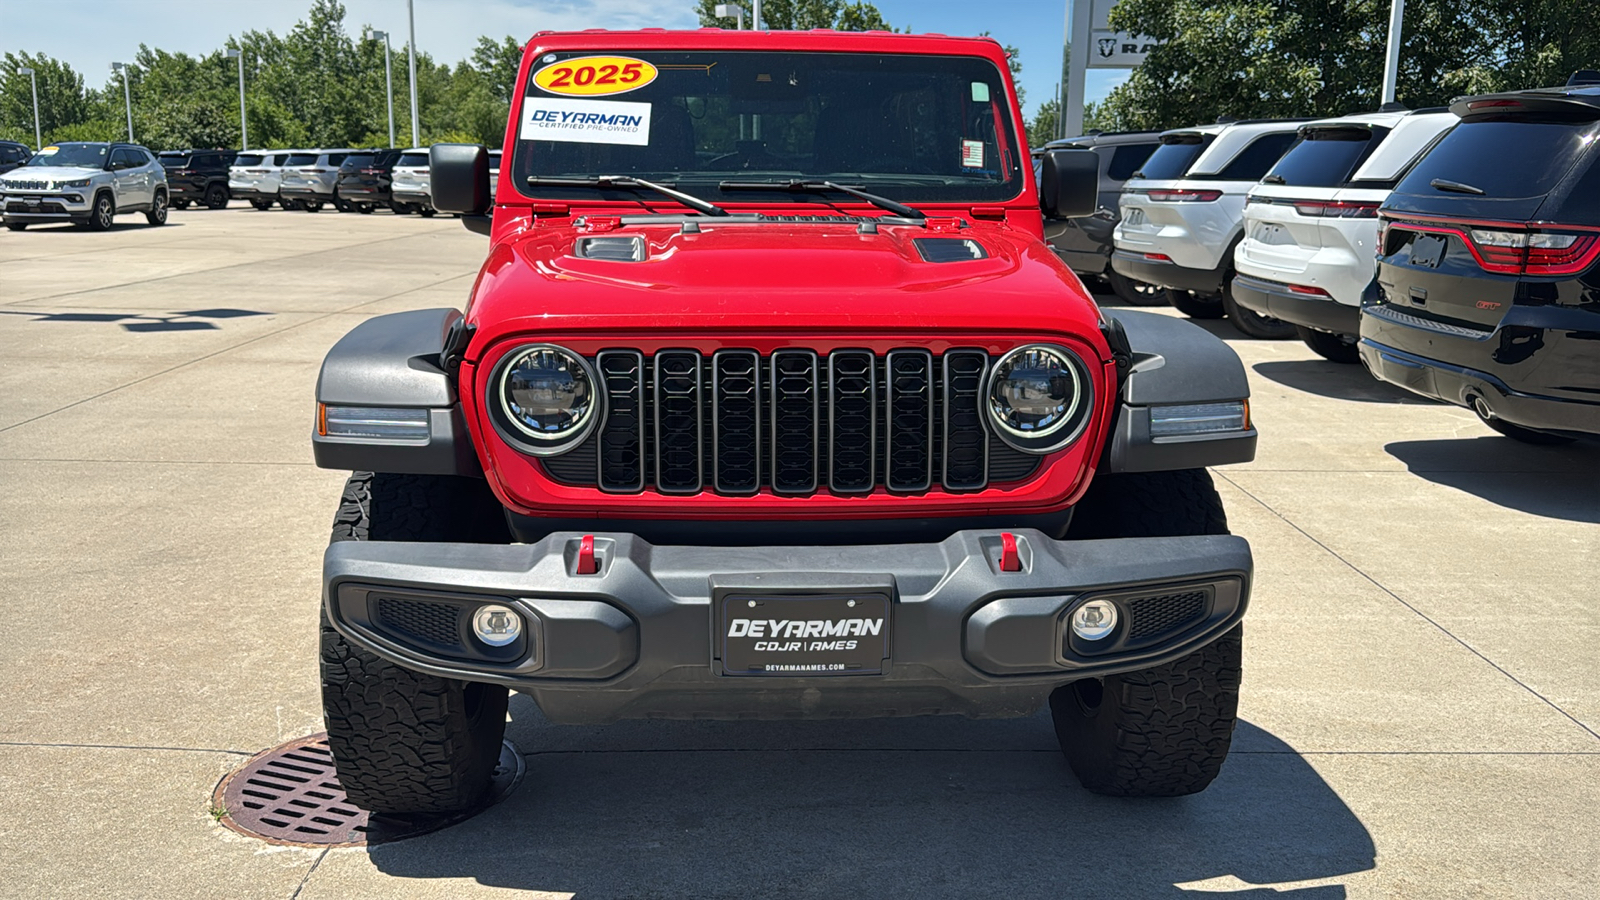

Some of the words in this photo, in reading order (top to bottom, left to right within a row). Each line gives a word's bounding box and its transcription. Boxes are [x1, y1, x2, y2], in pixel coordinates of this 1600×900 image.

[548, 63, 642, 88] 2025
[531, 109, 643, 126] DEYARMAN
[538, 121, 585, 129] CERTIFIED
[586, 123, 639, 133] PRE-OWNED
[727, 618, 884, 638] DEYARMAN
[754, 641, 802, 652] CDJR
[808, 640, 858, 651] AMES
[765, 663, 845, 672] DEYARMANAMES.COM
